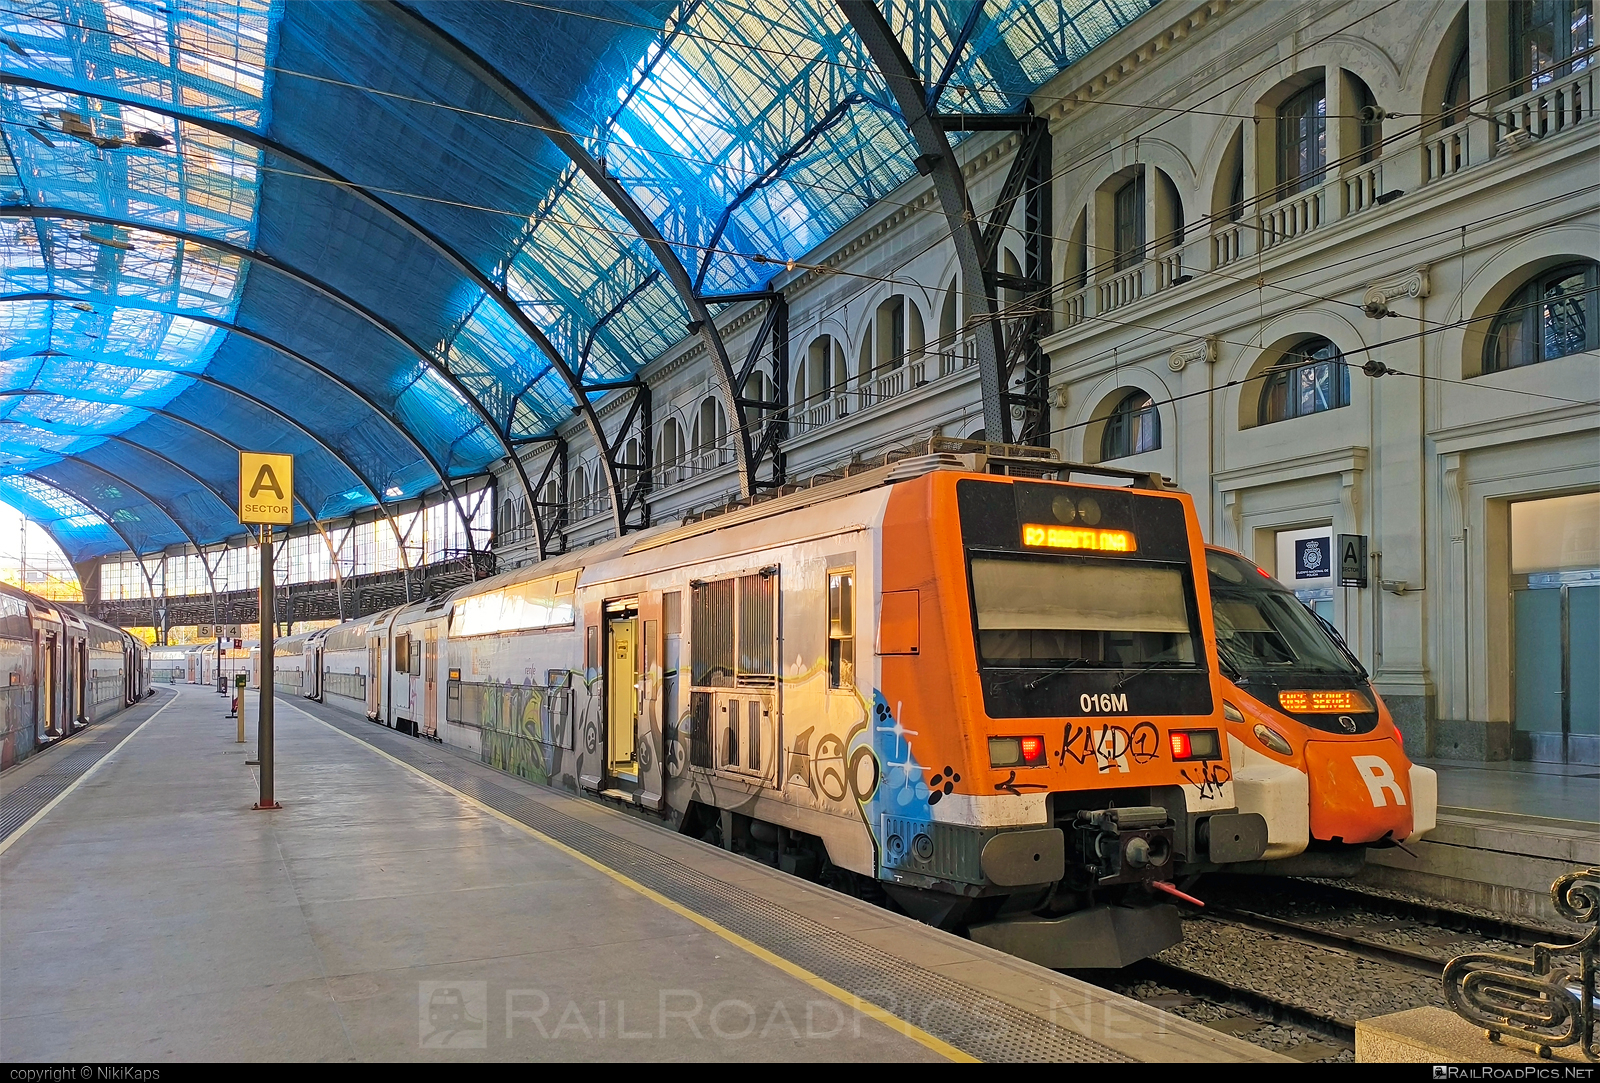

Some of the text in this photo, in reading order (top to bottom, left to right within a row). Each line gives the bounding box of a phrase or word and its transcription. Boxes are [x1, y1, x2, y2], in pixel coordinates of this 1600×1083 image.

[249, 464, 284, 500] A
[244, 504, 289, 514] SECTOR
[1343, 541, 1357, 564] A
[202, 626, 208, 635] 5
[230, 626, 236, 634] 4
[1080, 693, 1128, 712] 016M
[1351, 755, 1406, 808] R
